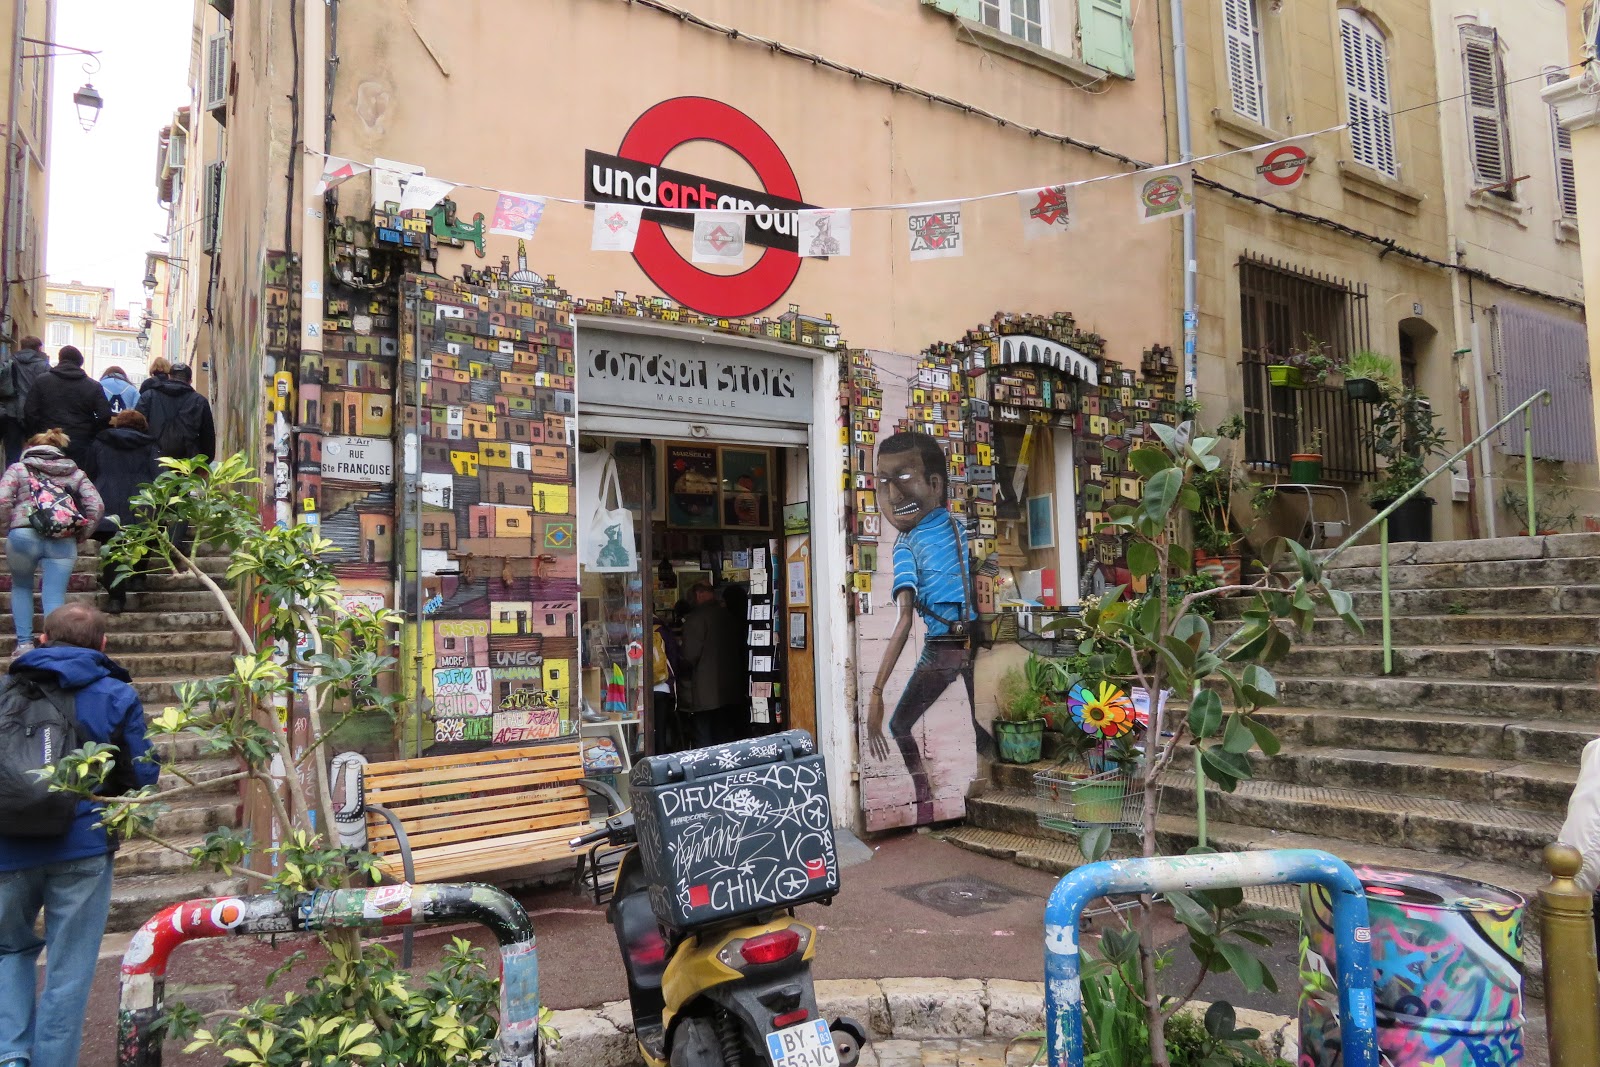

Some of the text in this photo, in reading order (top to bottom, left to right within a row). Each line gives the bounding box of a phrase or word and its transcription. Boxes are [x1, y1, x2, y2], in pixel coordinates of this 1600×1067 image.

[592, 164, 800, 239] undartgrou
[909, 211, 960, 231] STET
[656, 393, 737, 408] MARSEILLE
[349, 449, 365, 459] RUE
[672, 450, 712, 459] MARSEILLE
[322, 462, 391, 476] Ste FRANÇOISE
[819, 1032, 830, 1043] 83
[775, 1049, 780, 1057] F
